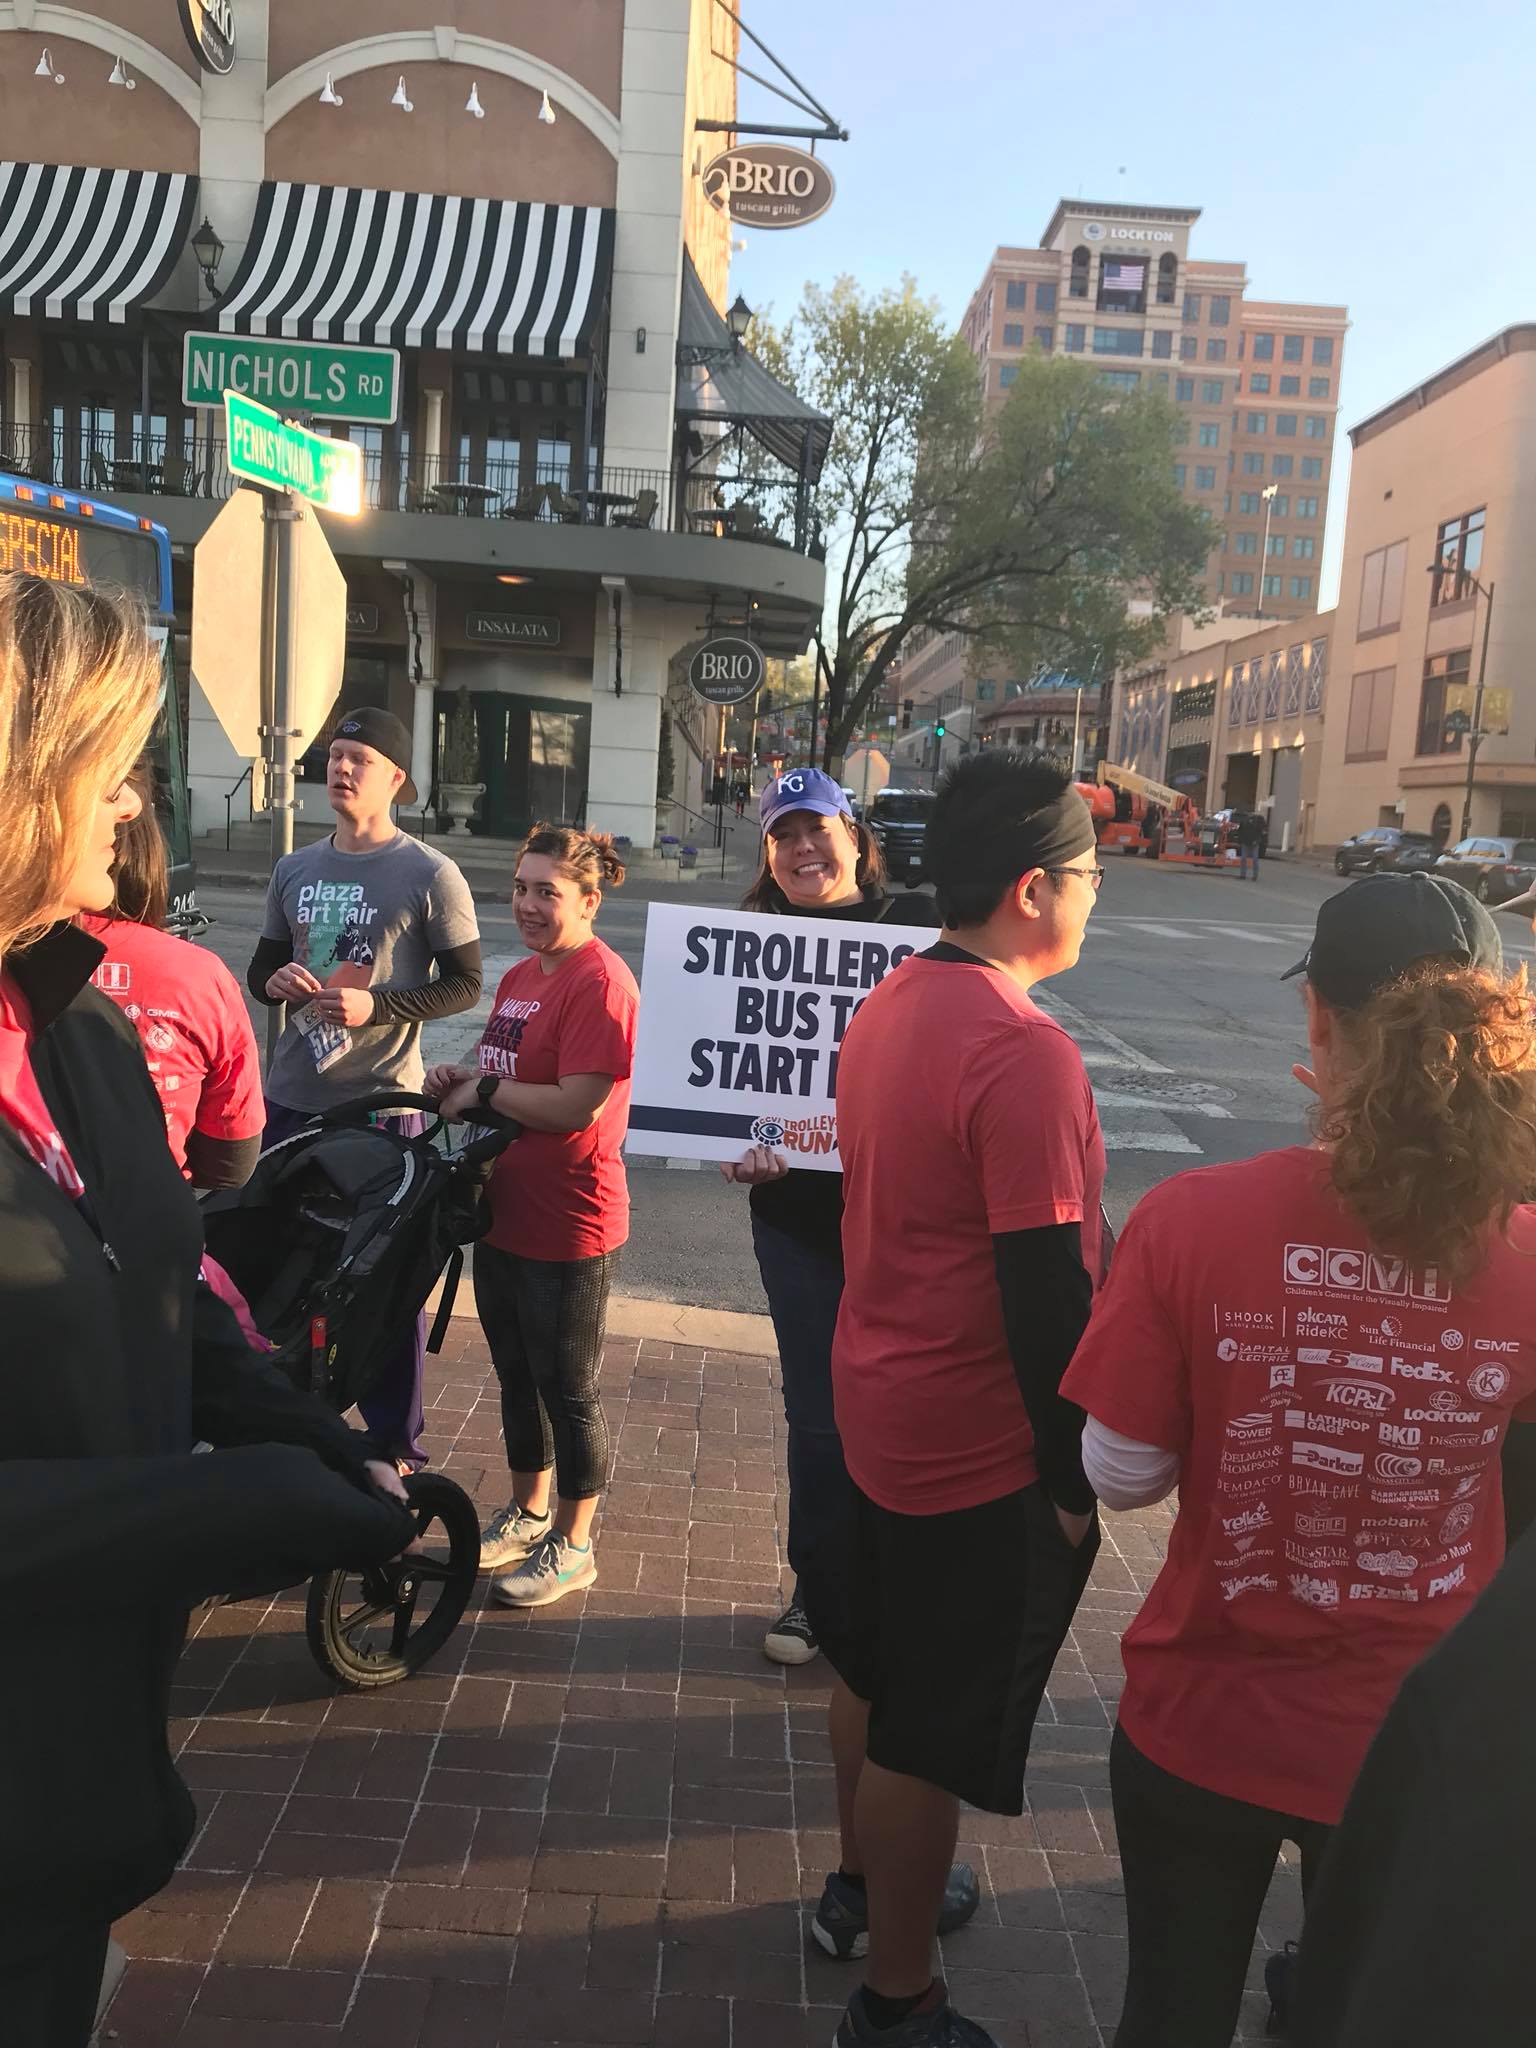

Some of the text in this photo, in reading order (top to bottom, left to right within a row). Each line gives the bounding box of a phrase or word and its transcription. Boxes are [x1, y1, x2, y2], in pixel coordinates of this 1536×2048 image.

[727, 157, 815, 197] BRIO
[735, 202, 802, 216] tuscan grille
[1111, 228, 1174, 242] LOCKTON
[193, 350, 384, 402] NICHOLS RD
[477, 619, 549, 637] INSALATA
[700, 652, 752, 679] BRIO
[777, 773, 804, 795] KC
[298, 880, 364, 907] plaza
[297, 902, 378, 925] art fair
[147, 1009, 180, 1019] GMC
[735, 986, 868, 1043] BUS T
[687, 1038, 819, 1097] START
[784, 1115, 836, 1132] TROLLEY
[783, 1129, 834, 1154] RUN
[1286, 1246, 1446, 1300] CCVI
[1285, 1286, 1324, 1298] Children's
[1325, 1290, 1350, 1300] Center
[1365, 1295, 1378, 1303] the
[1379, 1297, 1410, 1309] Visually
[1411, 1301, 1448, 1313] Impaired
[1225, 1312, 1273, 1324] SHOOK
[1296, 1325, 1348, 1340] RideKC
[1359, 1324, 1379, 1335] Sun
[1369, 1335, 1436, 1352] Life Financial
[1474, 1339, 1520, 1353] GMC
[1326, 1384, 1387, 1411] KCP&L
[1308, 1412, 1370, 1432] LATHROP
[1404, 1408, 1481, 1422] LOCKTON
[1307, 1421, 1344, 1435] GAGE
[1379, 1422, 1421, 1446] BKD
[1272, 1445, 1284, 1456] &
[1308, 1450, 1362, 1473] Parker
[1289, 1474, 1327, 1498] BRYAN
[1333, 1484, 1360, 1499] CAVE
[1370, 1494, 1440, 1504] RUNNING SPORTS
[1361, 1517, 1430, 1528] mobank
[1315, 1545, 1350, 1559] STAR
[1214, 1558, 1240, 1568] WARD
